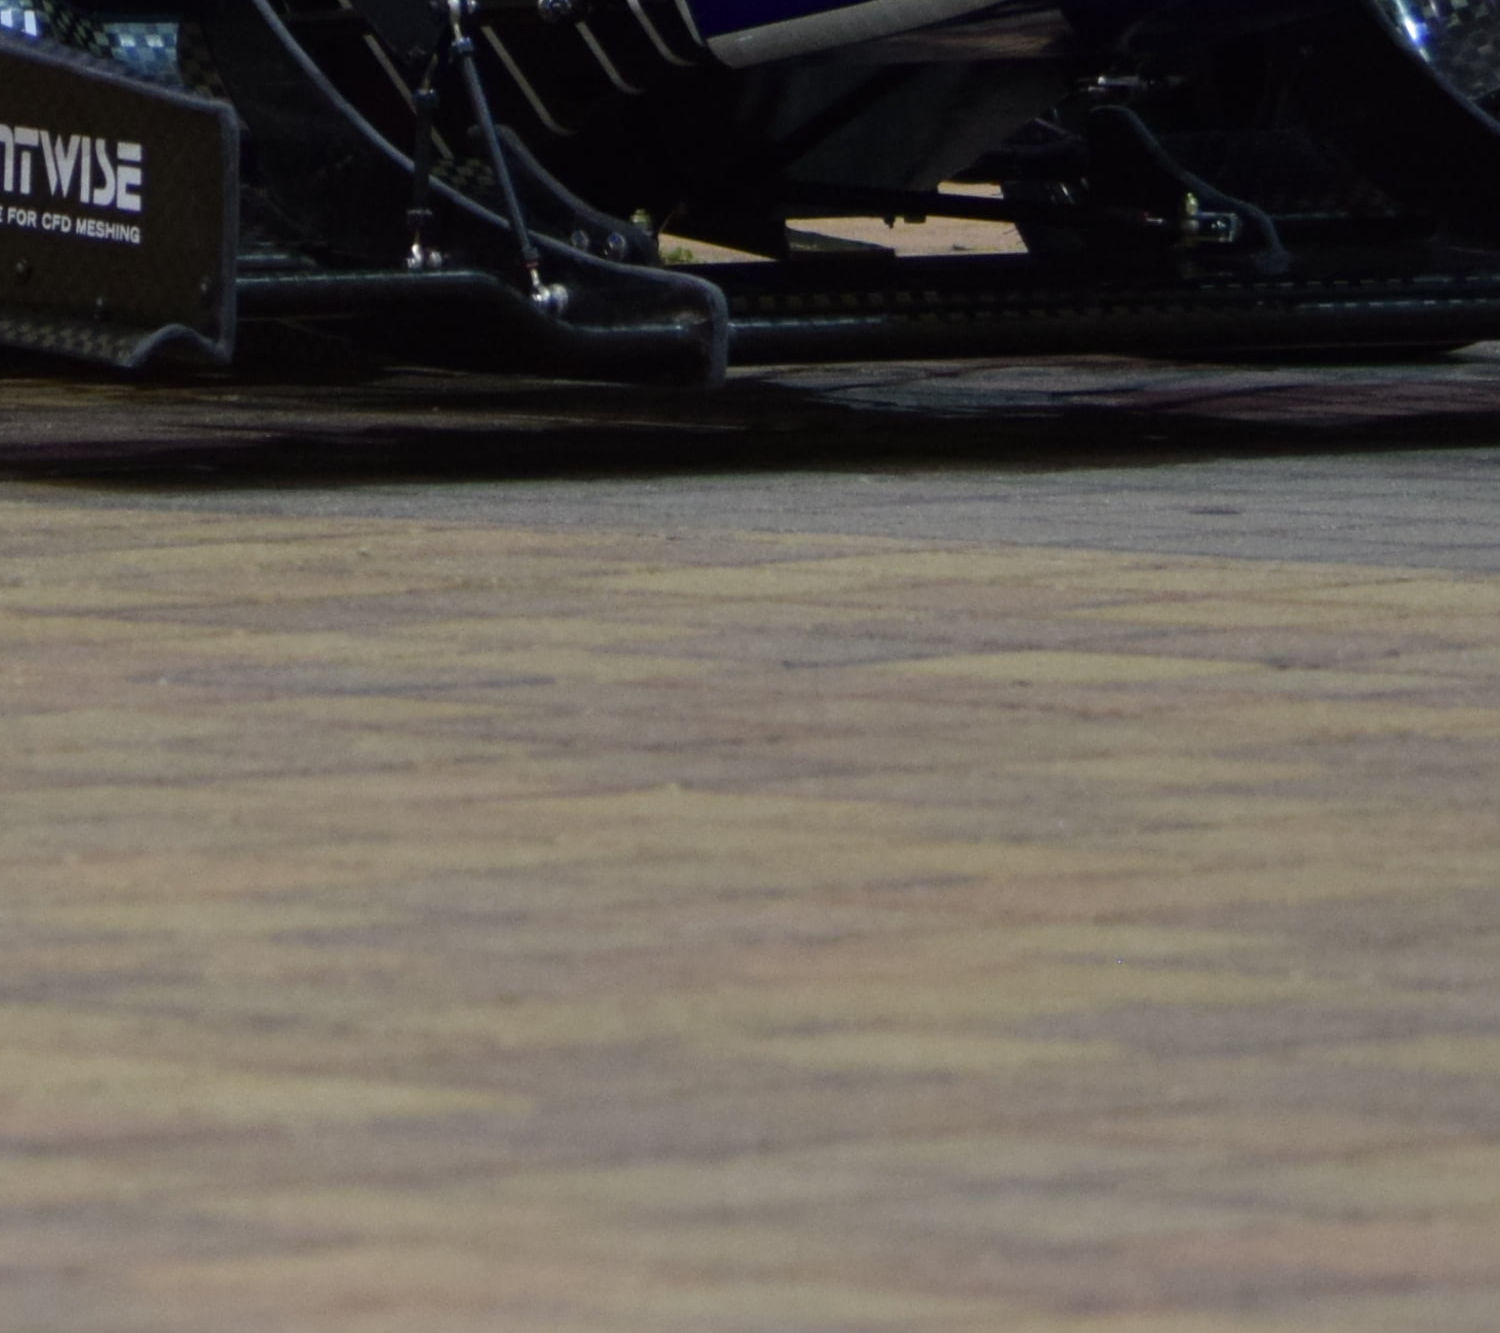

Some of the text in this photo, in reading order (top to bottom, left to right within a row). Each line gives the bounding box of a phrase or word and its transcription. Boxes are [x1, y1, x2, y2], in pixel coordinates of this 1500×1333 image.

[7, 206, 37, 228] FOR
[42, 212, 71, 233] CFD
[76, 218, 141, 244] MESHING
